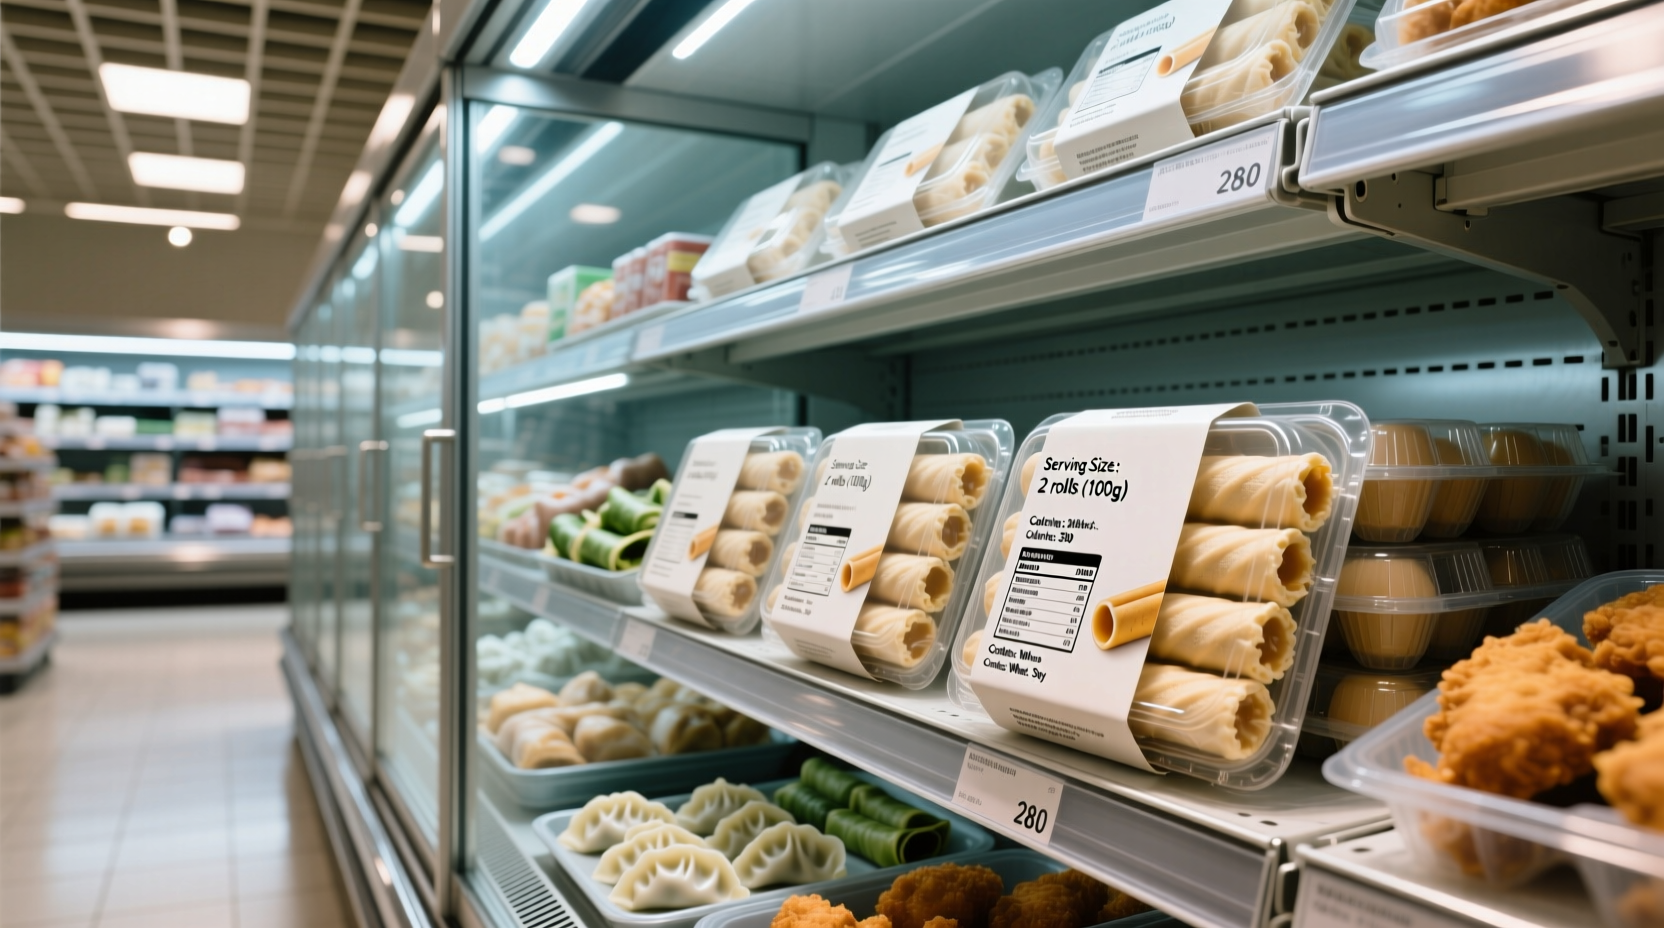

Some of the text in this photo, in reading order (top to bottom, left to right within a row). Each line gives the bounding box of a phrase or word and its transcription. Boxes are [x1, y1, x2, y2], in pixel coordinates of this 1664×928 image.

[1216, 162, 1261, 195] 280
[1043, 457, 1120, 476] Serving Size:
[1037, 477, 1128, 502] 2 rolls (100g)
[1013, 800, 1048, 834] 280
